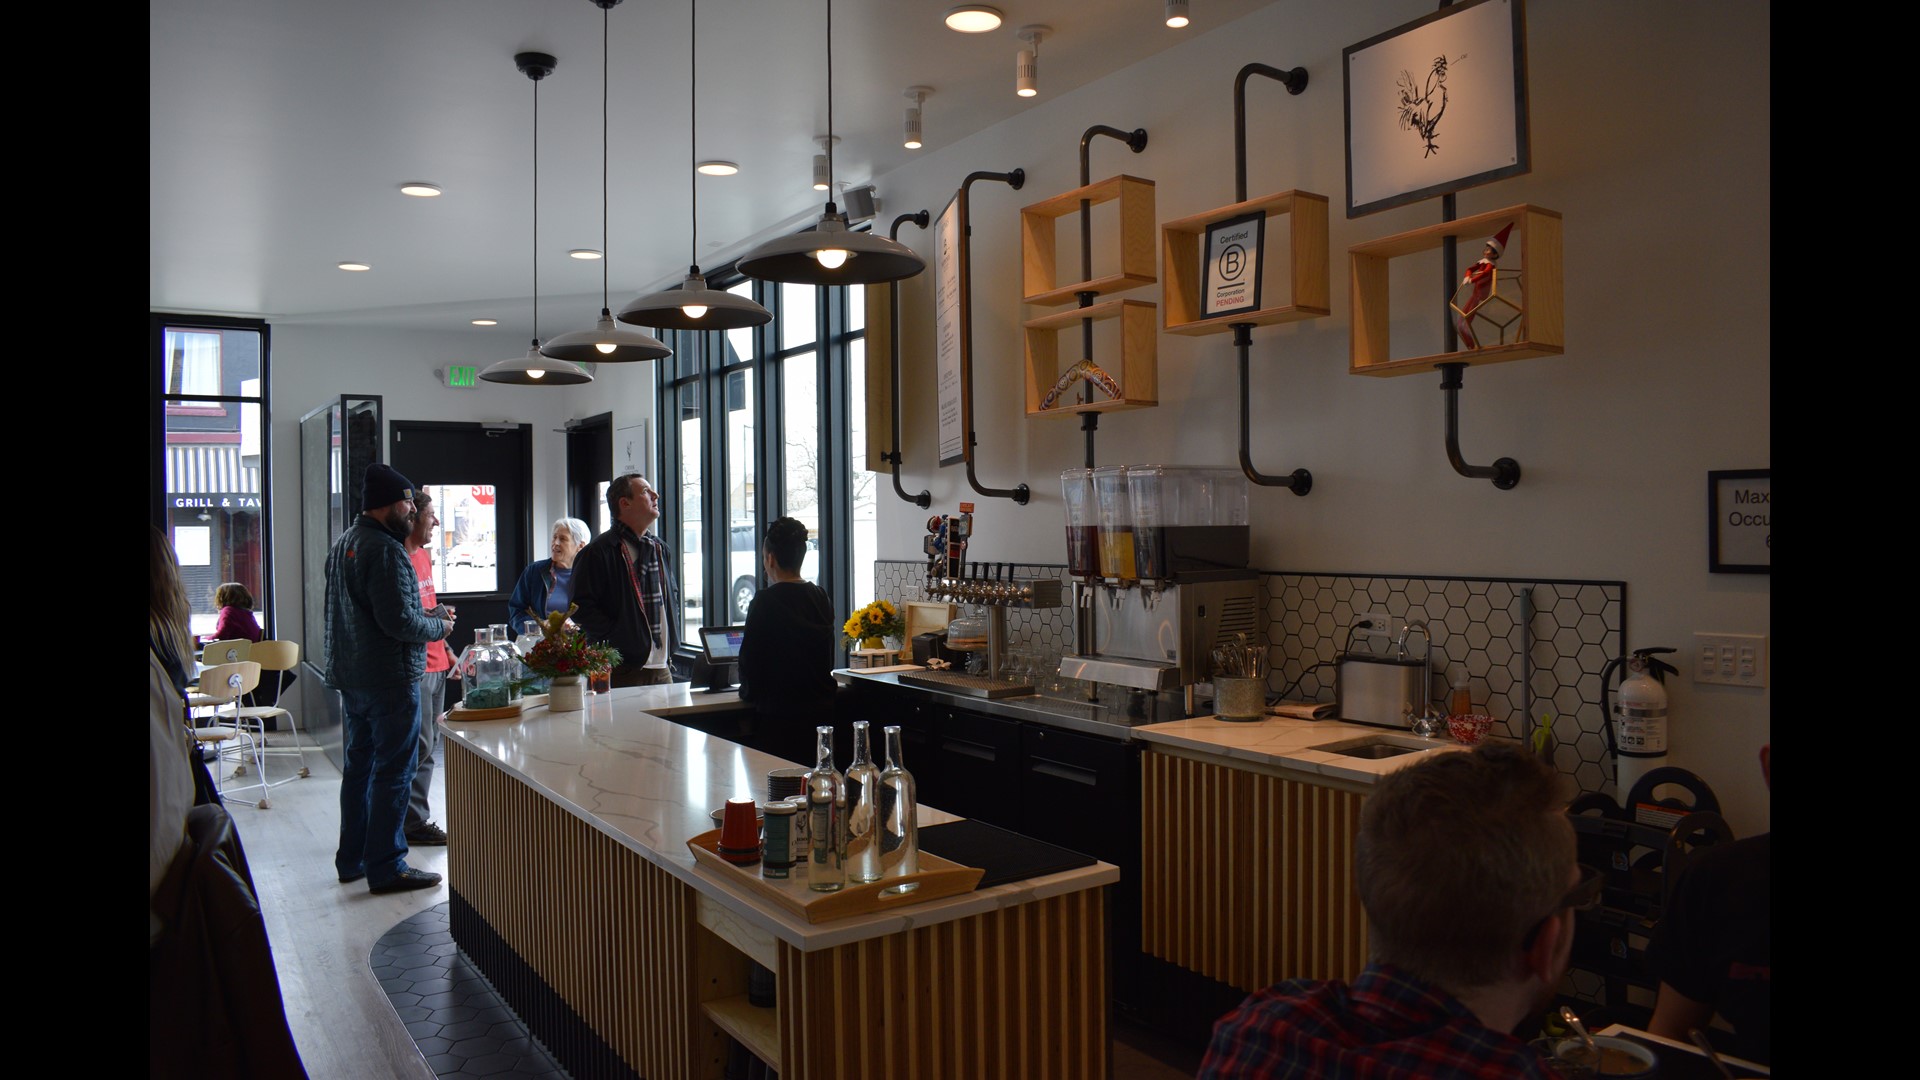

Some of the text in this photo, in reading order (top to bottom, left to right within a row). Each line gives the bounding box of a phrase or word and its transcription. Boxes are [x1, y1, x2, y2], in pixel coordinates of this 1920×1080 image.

[1220, 231, 1249, 244] Certified
[1226, 251, 1239, 274] B
[1217, 288, 1245, 298] Corporation
[1216, 296, 1245, 307] PENDING
[450, 366, 475, 386] EXIT
[175, 498, 213, 507] GRILL
[221, 498, 231, 507] &
[1735, 489, 1770, 504] Max
